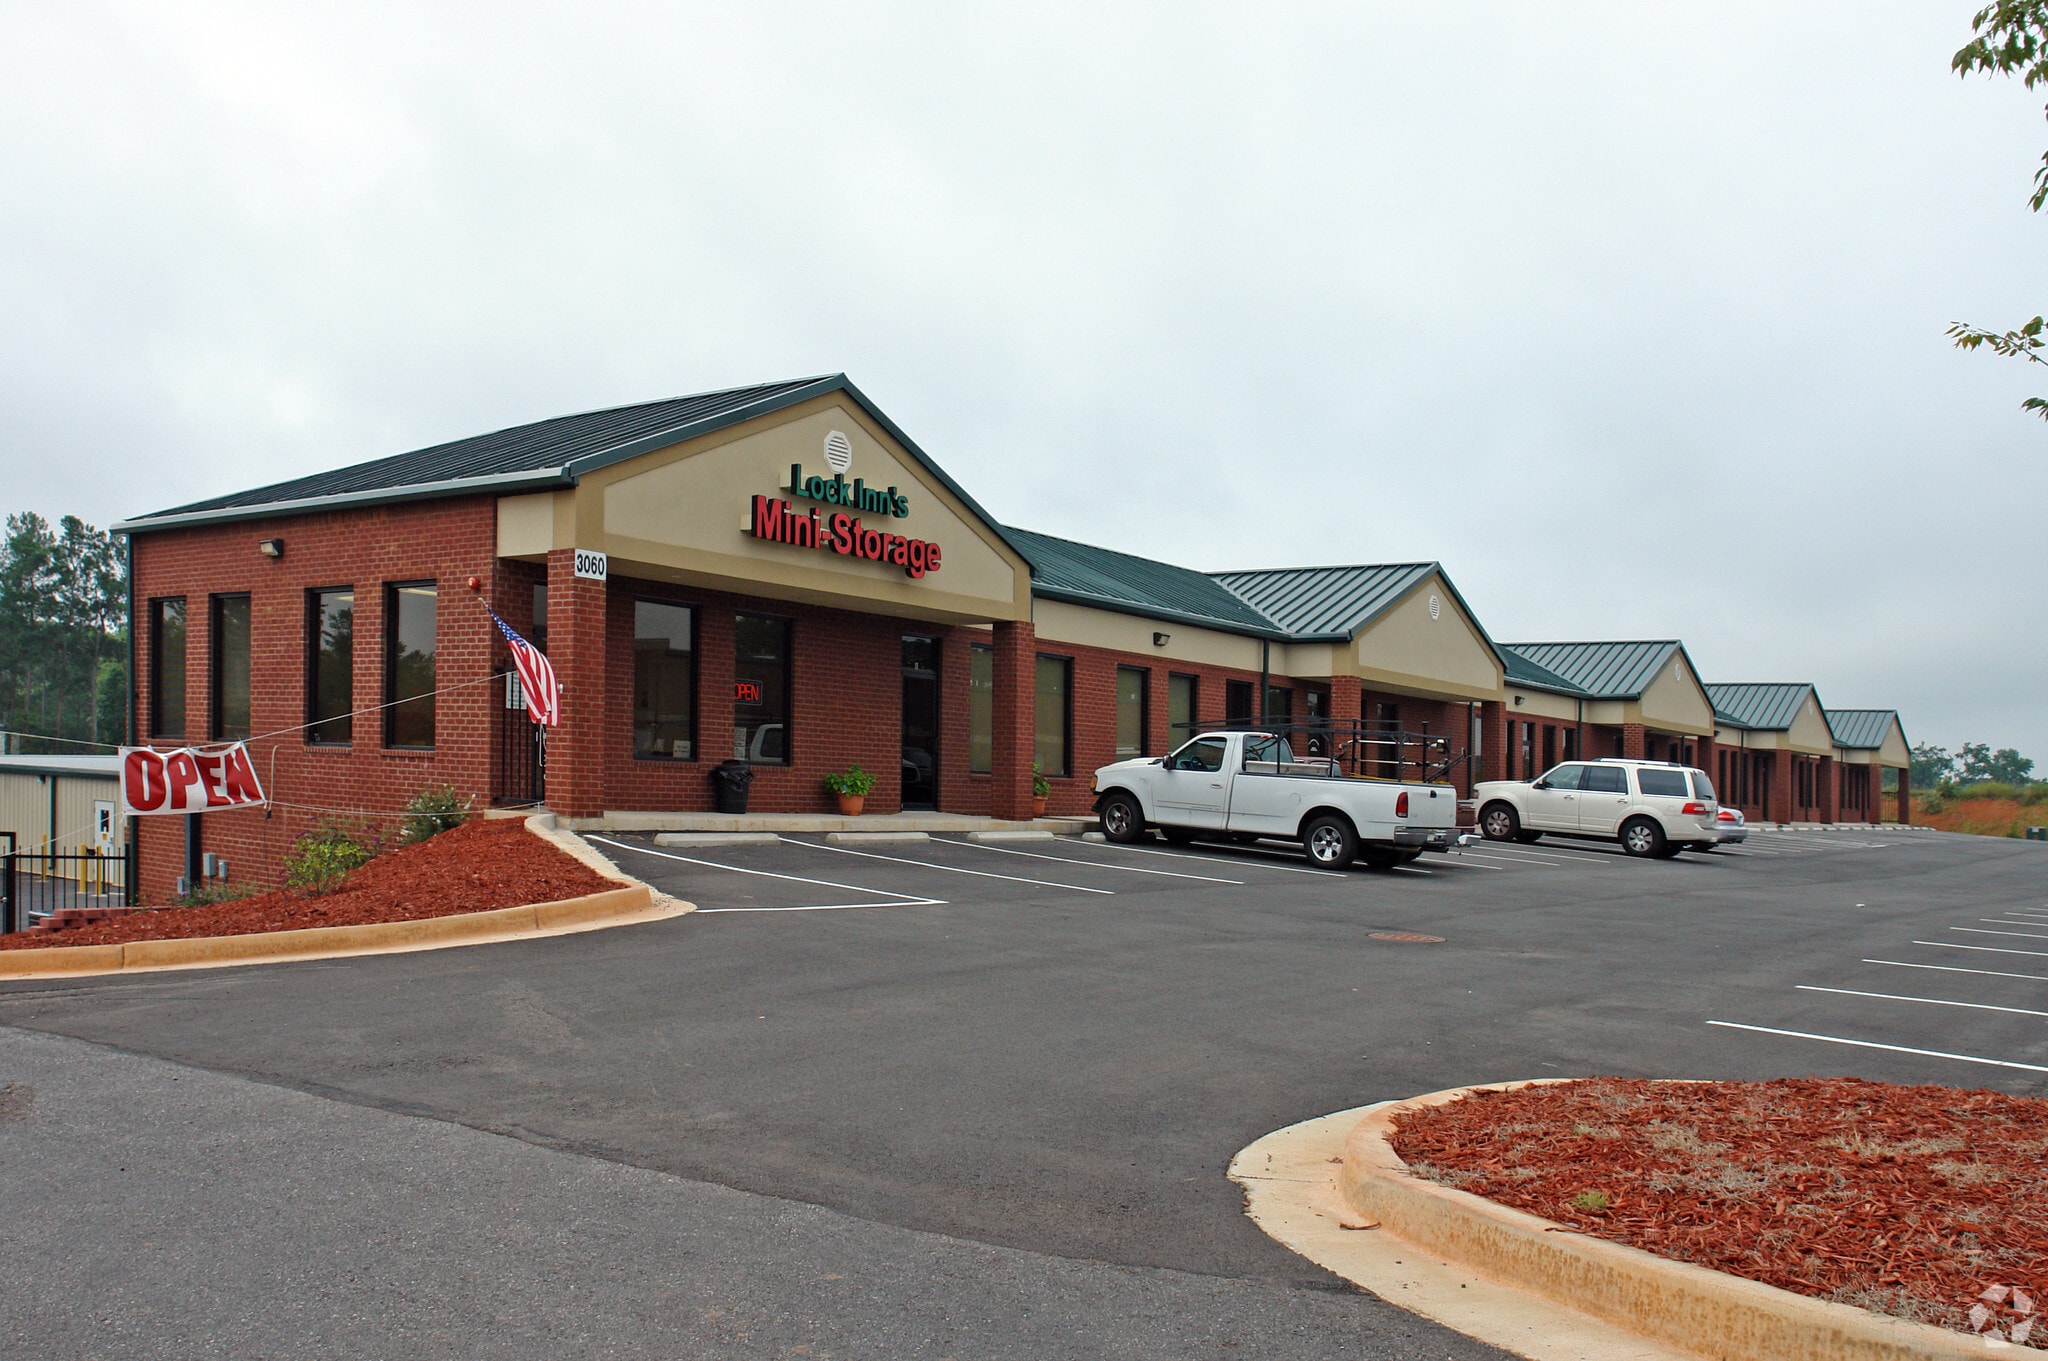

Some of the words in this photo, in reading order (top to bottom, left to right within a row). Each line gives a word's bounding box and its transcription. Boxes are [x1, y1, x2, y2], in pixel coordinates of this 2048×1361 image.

[791, 463, 852, 507] Lock
[853, 478, 909, 518] Inn's
[751, 494, 942, 579] Mini-Storage
[576, 553, 605, 576] 3060
[734, 683, 759, 701] OPEN
[124, 744, 263, 811] OPEN
